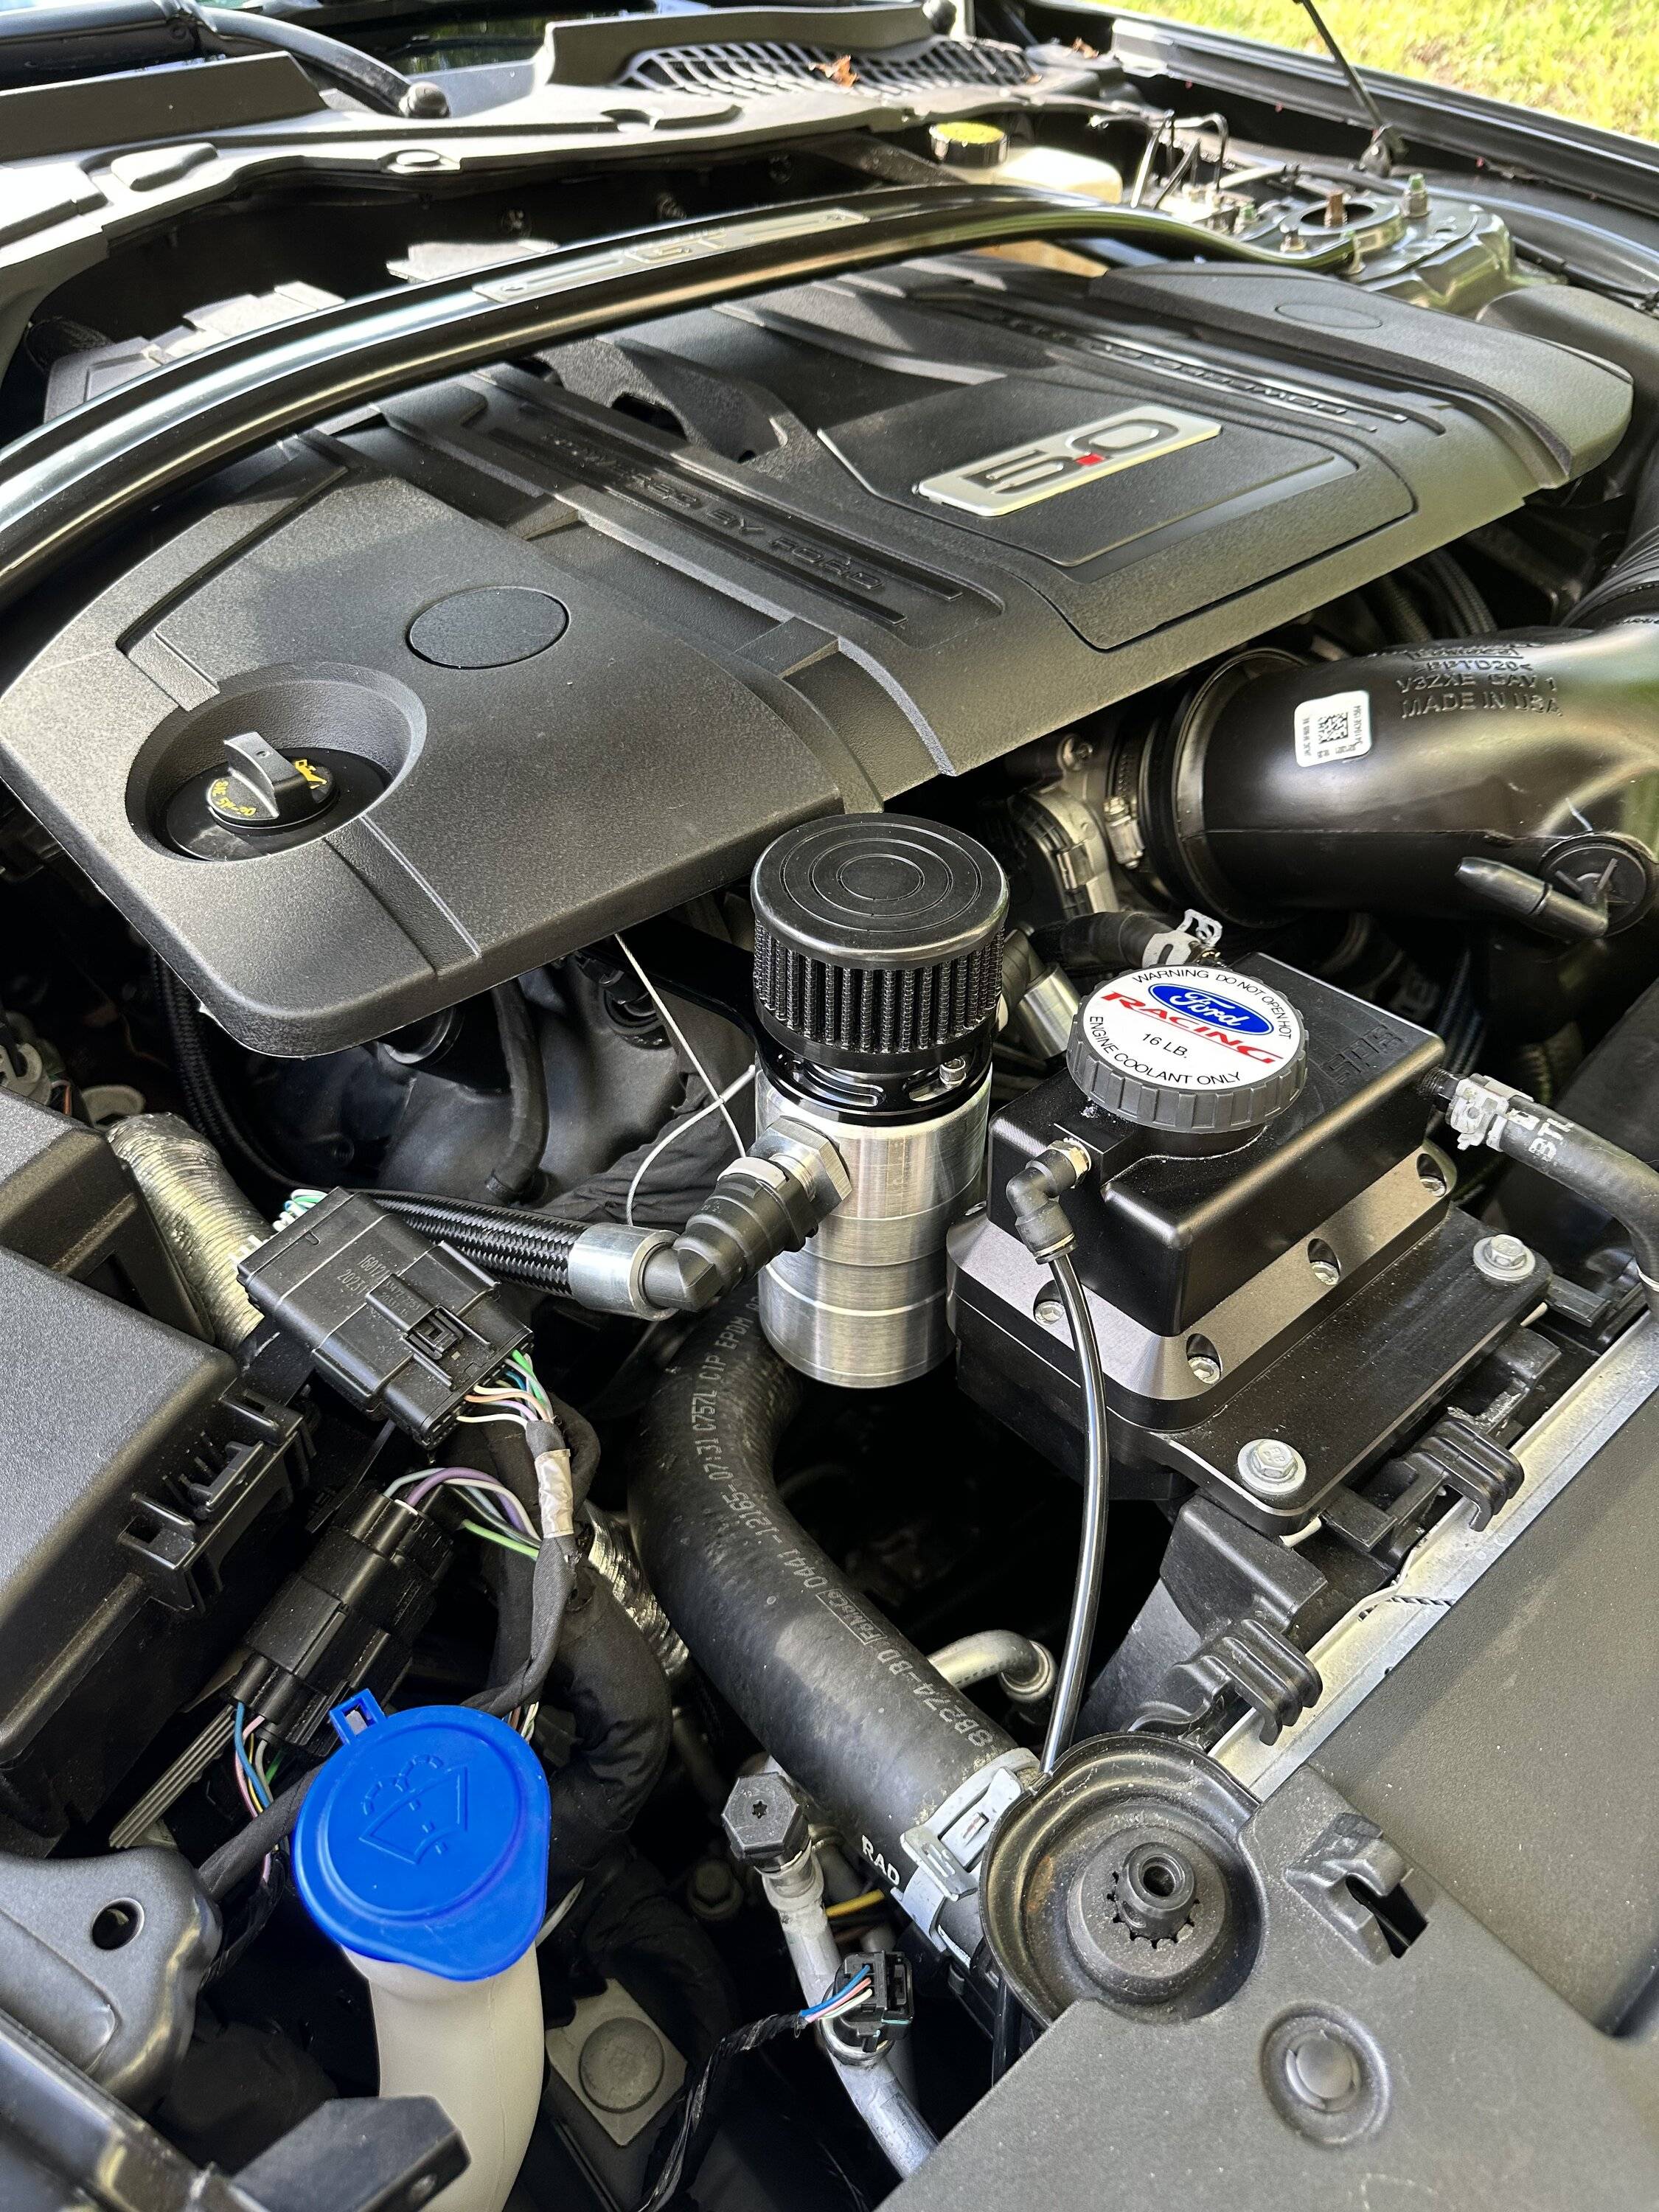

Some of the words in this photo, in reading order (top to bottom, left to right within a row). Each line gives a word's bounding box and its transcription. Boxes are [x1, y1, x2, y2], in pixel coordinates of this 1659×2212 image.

[959, 419, 1182, 495] 5.0
[706, 507, 765, 534] BY
[770, 536, 883, 590] FORD
[1401, 691, 1477, 720] MADE
[1482, 691, 1506, 710] IN
[1514, 692, 1564, 717] USA
[212, 780, 229, 797] SAE
[1101, 991, 1284, 1064] RACING
[1132, 969, 1209, 984] WARNING
[1215, 974, 1237, 985] DO
[1237, 981, 1265, 996] NOT
[1262, 995, 1287, 1020] OPEN
[1277, 1020, 1293, 1040] HOT
[1169, 991, 1251, 1027] Ford
[1089, 1015, 1120, 1054] ENGINE
[1114, 1052, 1194, 1085] COOLANT
[1196, 1071, 1242, 1086] ONLY
[1141, 1033, 1162, 1046] 16
[1162, 1042, 1189, 1059] LB.
[691, 1389, 718, 1432] C757L
[715, 1315, 755, 1350] EPDM
[861, 1834, 901, 1885] RAD
